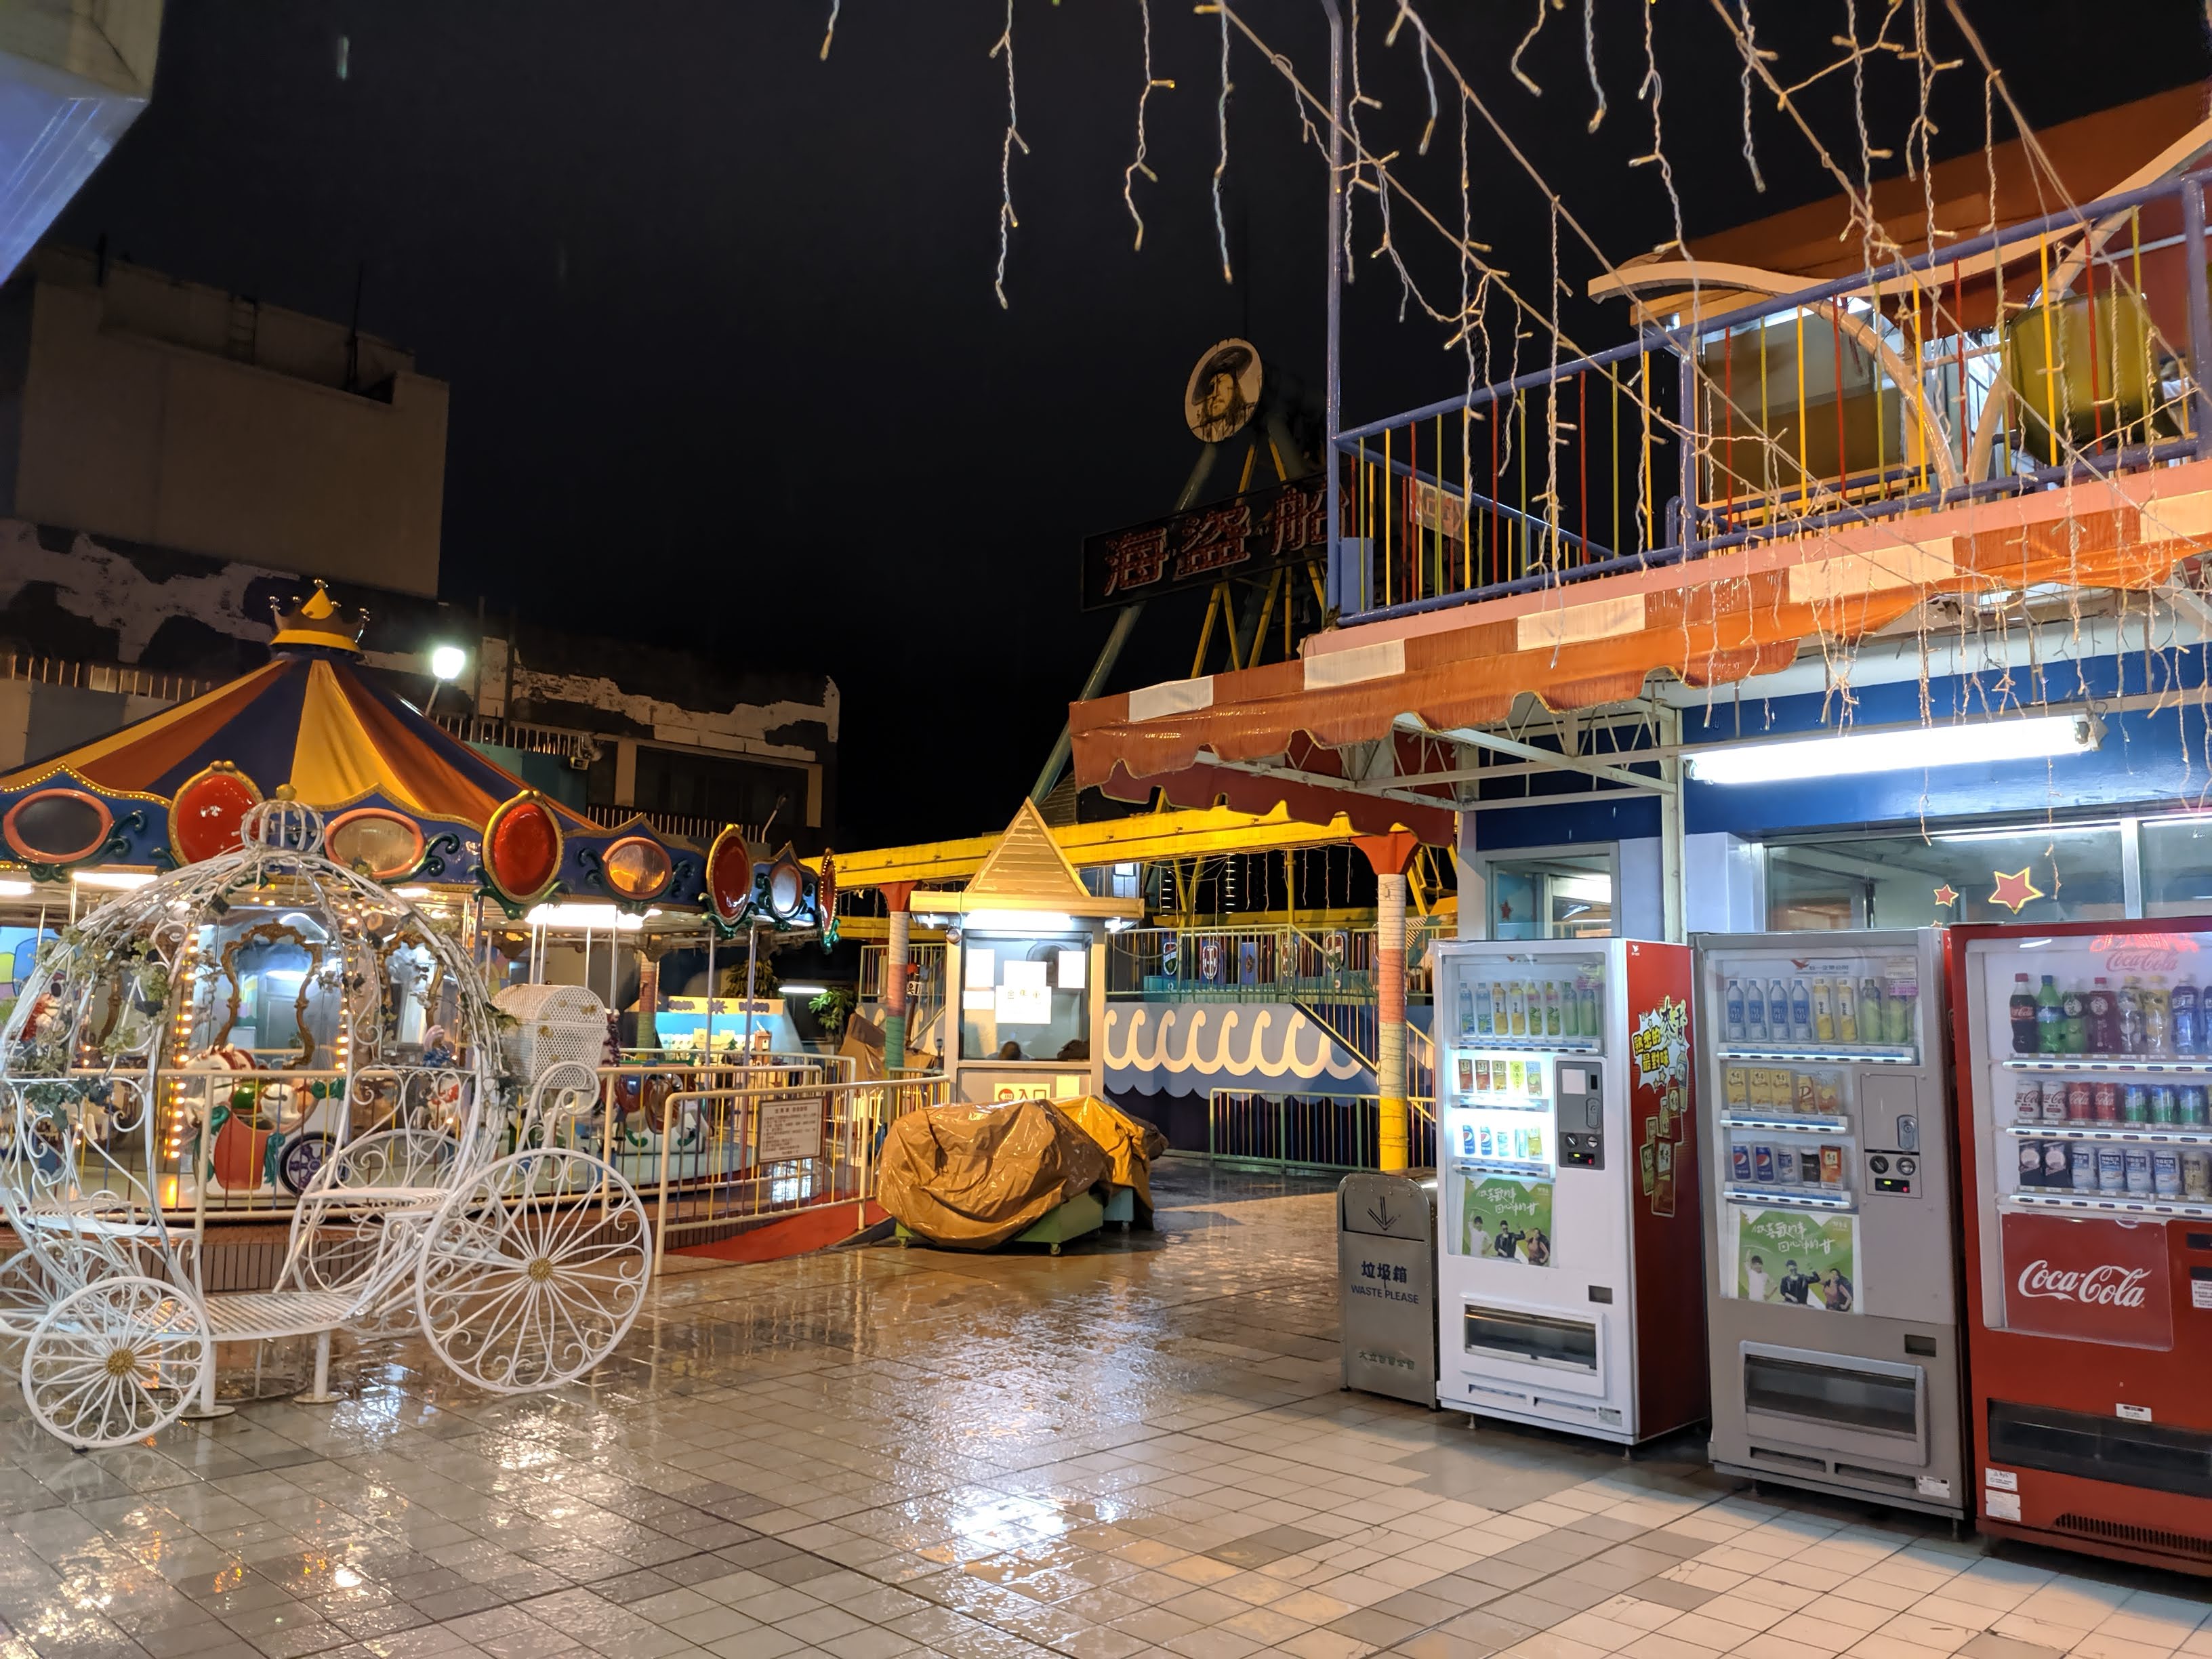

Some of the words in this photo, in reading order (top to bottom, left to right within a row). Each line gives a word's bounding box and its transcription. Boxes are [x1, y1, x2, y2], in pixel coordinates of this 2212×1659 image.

[1105, 476, 1350, 596] 海盜船
[1633, 1025, 1662, 1055] 熟悉的
[1641, 1047, 1669, 1073] 最對味
[1361, 1261, 1407, 1284] 垃圾箱
[2018, 1259, 2153, 1308] Coca-Cola
[1351, 1284, 1382, 1298] WASTE
[1385, 1290, 1420, 1305] PLEASE
